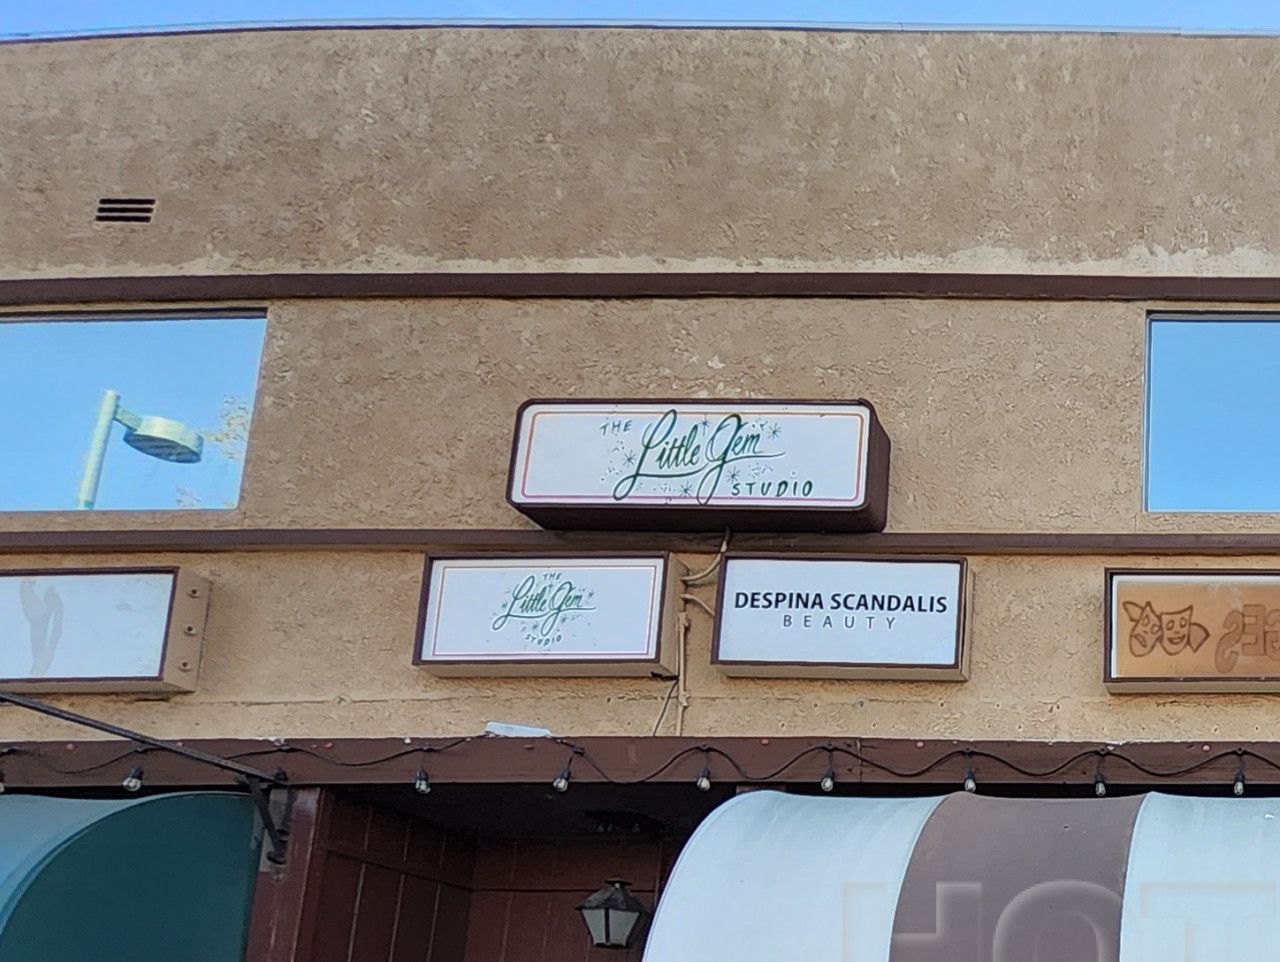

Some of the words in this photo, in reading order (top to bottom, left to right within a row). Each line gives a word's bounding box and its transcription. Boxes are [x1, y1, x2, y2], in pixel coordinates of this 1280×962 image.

[599, 419, 632, 437] THE
[613, 409, 708, 500] Little
[697, 413, 786, 506] Gem
[731, 480, 813, 497] STUDIO
[543, 572, 562, 581] THE
[492, 575, 549, 630] Little
[540, 581, 596, 637] Gem
[735, 592, 824, 610] DESPINA
[830, 593, 948, 613] SCANDALIS
[783, 615, 896, 629] BEAUTY
[525, 633, 562, 647] STUDIO
